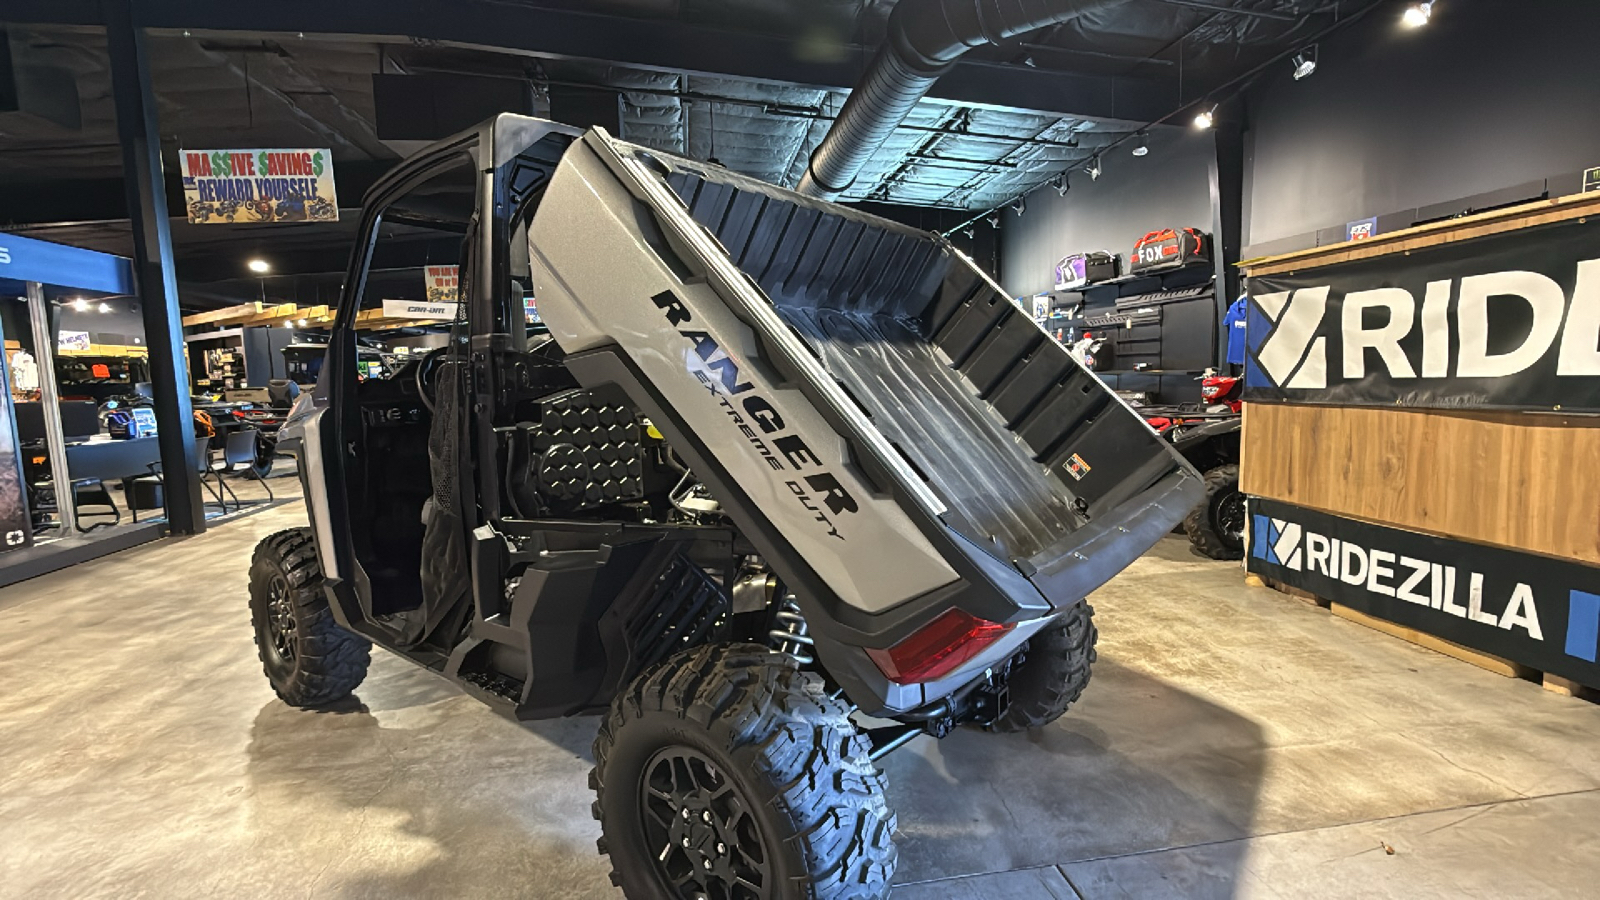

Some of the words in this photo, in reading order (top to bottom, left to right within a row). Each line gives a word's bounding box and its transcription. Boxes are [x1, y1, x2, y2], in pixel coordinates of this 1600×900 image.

[198, 178, 253, 202] REWARD
[255, 178, 318, 201] YOURSELF
[1138, 244, 1163, 263] FOX
[650, 289, 859, 516] RANGER
[693, 369, 785, 471] EXTREME
[785, 480, 846, 541] DUTY
[1306, 531, 1544, 641] RIDEZILLA
